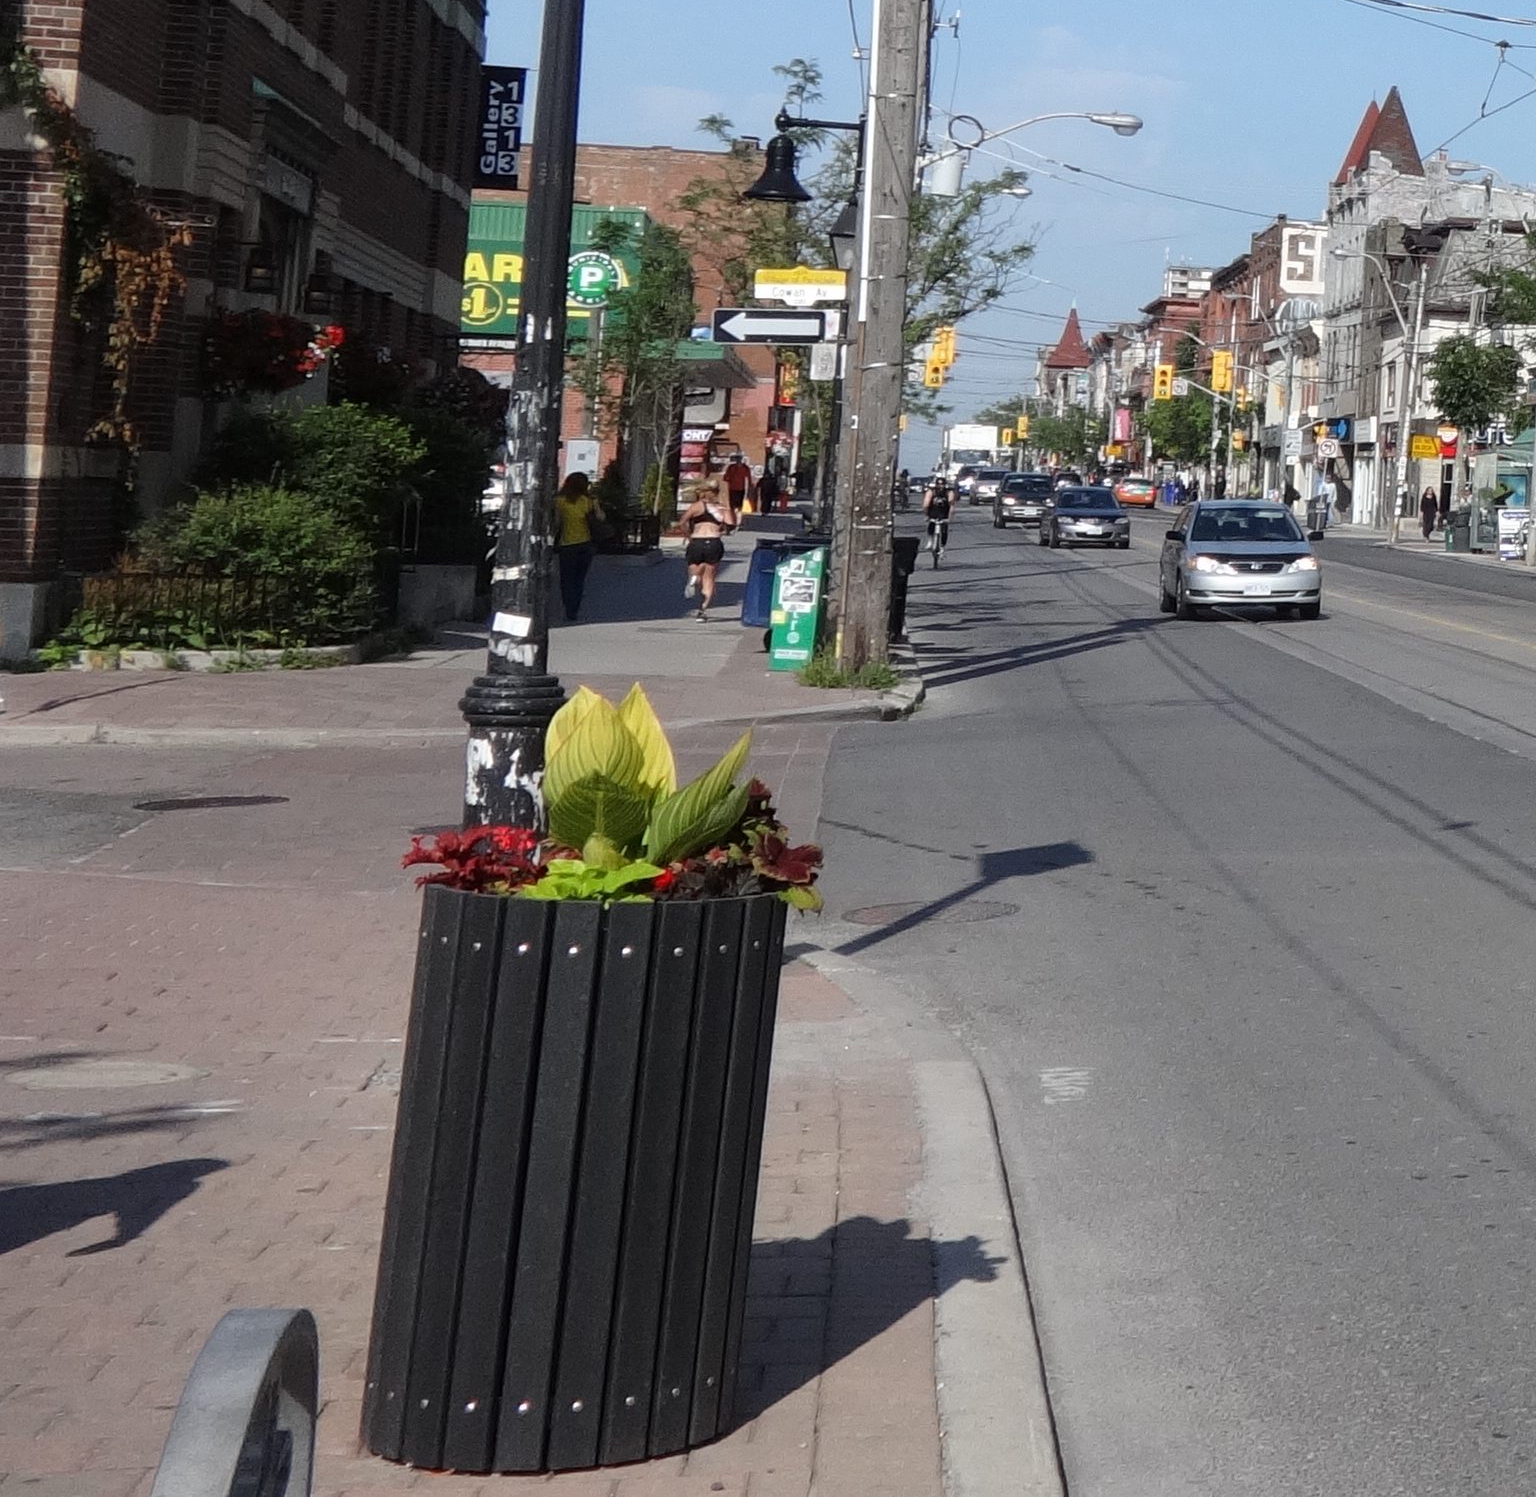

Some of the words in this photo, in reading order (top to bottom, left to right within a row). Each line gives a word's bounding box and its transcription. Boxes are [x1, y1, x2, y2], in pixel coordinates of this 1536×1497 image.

[479, 80, 505, 174] Gallery
[580, 266, 604, 288] P
[772, 286, 805, 298] Cowan
[815, 287, 827, 298] Av
